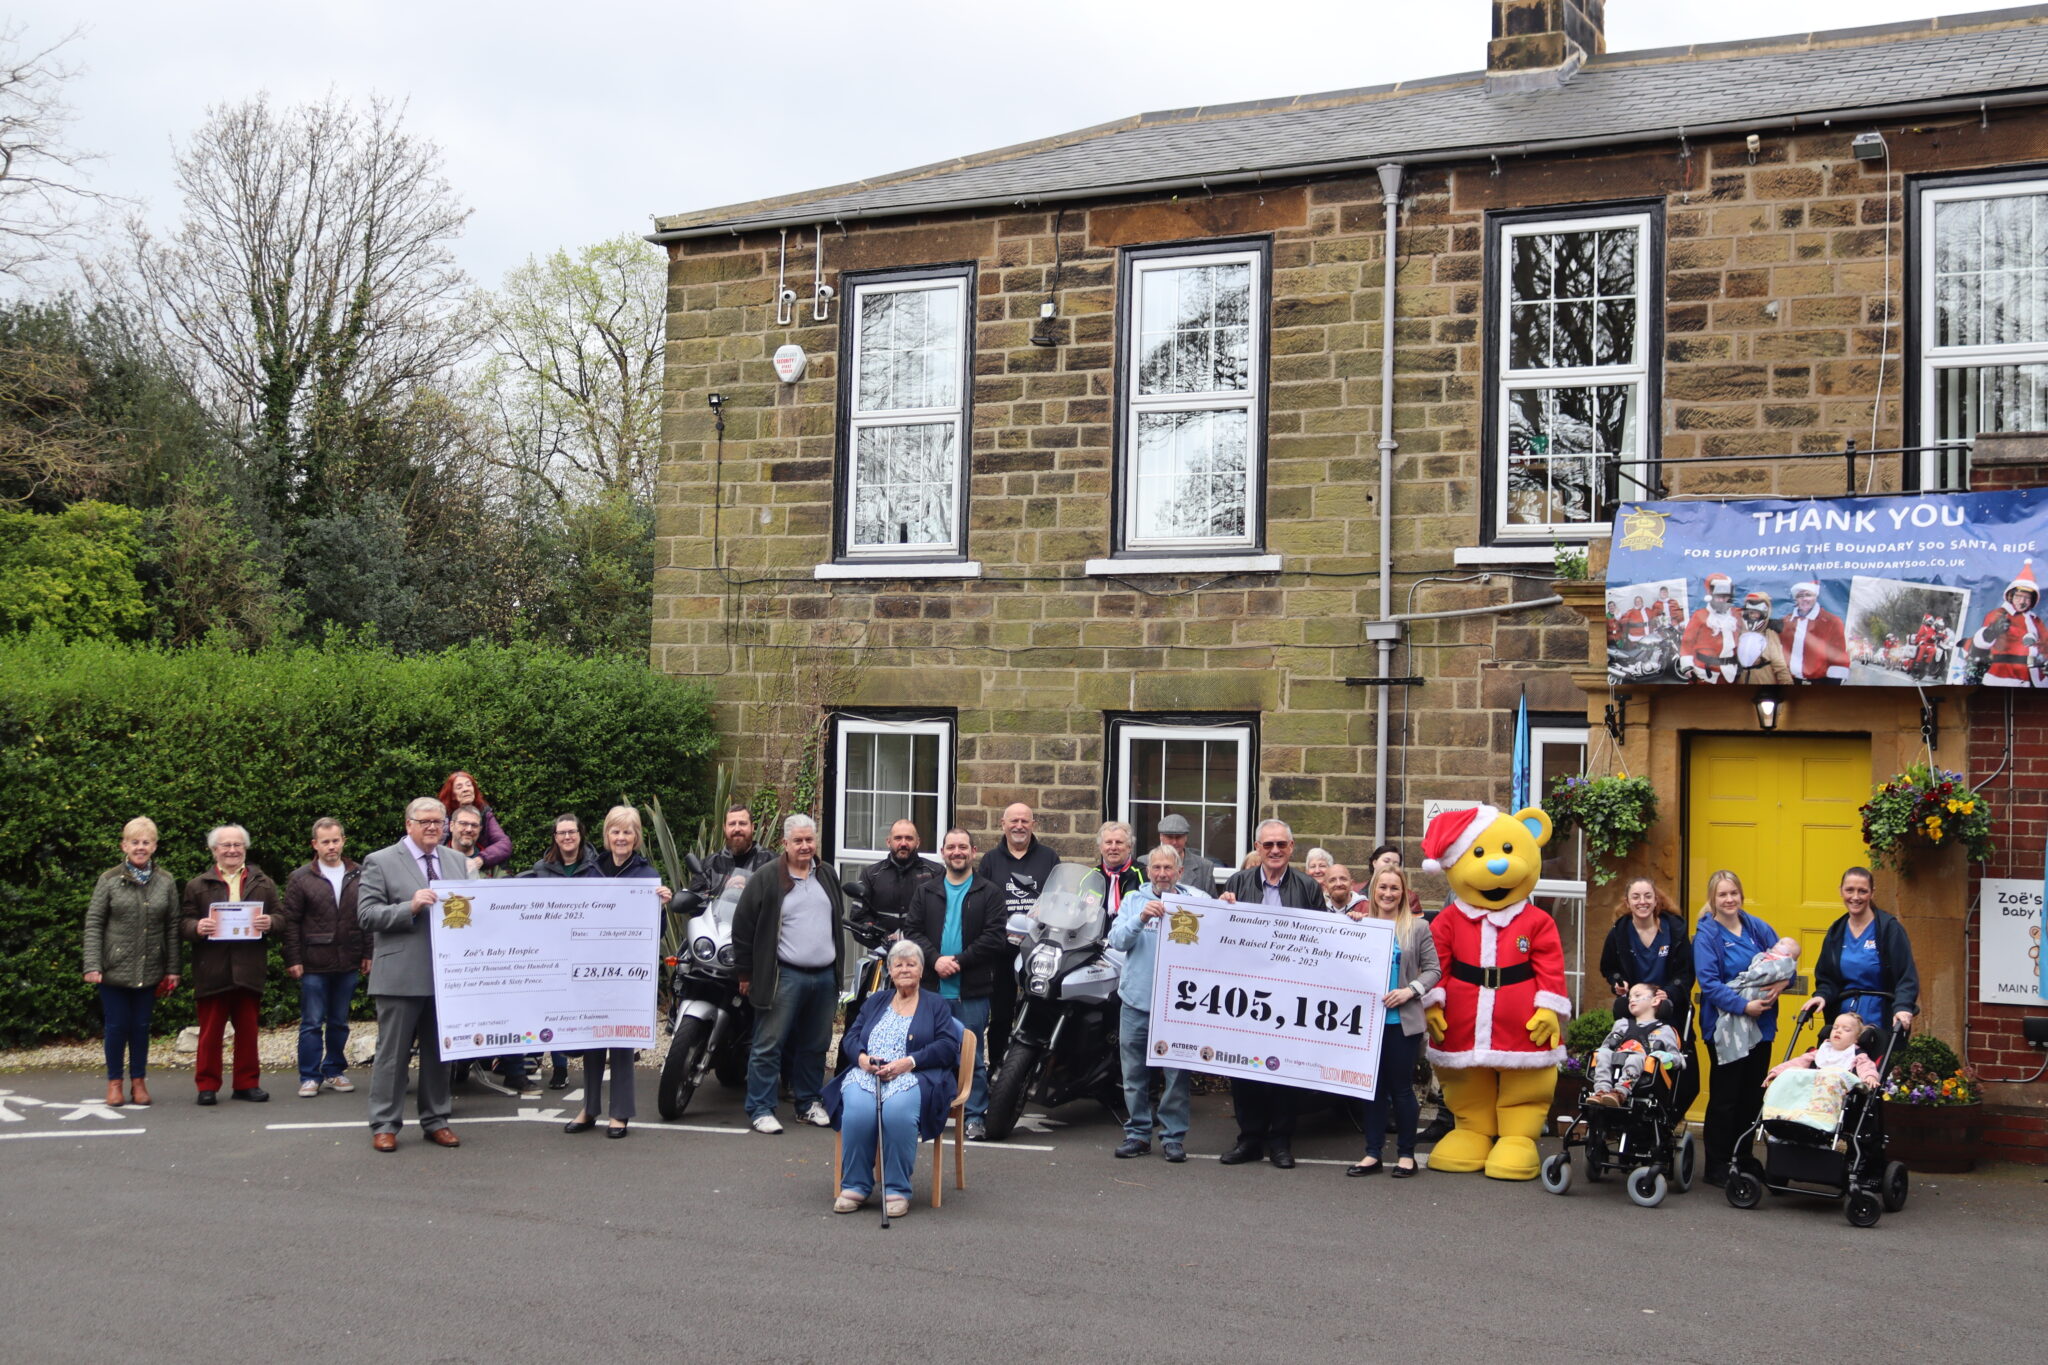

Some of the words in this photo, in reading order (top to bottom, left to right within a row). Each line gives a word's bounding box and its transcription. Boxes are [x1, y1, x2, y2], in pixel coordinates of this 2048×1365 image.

[1752, 508, 1877, 536] THANK
[1888, 503, 1965, 530] YOU
[1684, 548, 1710, 558] FOR
[1714, 544, 1801, 558] SUPPORTING
[1805, 542, 1831, 555] THE
[1835, 540, 1914, 553] BOUNDARY
[1918, 541, 1945, 551] 500
[1950, 539, 1997, 552] SANTA
[2002, 540, 2036, 553] RIDE
[1746, 558, 1966, 572] WWW.SANTARIDE.BOUNDARY500.CO.UK
[1998, 892, 2043, 905] Zoë's
[489, 902, 528, 911] Boundary
[546, 901, 589, 910] Motorcycle
[591, 901, 617, 910] Group
[2002, 907, 2035, 919] Baby
[519, 912, 542, 920] Santa
[544, 912, 563, 920] Ride
[1229, 914, 1272, 927] Boundary
[1273, 918, 1290, 928] 500
[1290, 920, 1338, 935] Motorcycle
[1339, 927, 1367, 940] Group
[1272, 930, 1297, 941] Santa
[486, 947, 506, 958] Baby
[508, 946, 540, 957] Hospice
[1219, 935, 1237, 945] Has
[1238, 937, 1268, 949] Raised
[1269, 941, 1286, 951] For
[1311, 947, 1333, 959] Baby
[1270, 953, 1291, 963] 2006
[1298, 956, 1319, 967] 2023
[573, 967, 581, 978] £
[628, 966, 649, 980] 60p
[1998, 983, 2028, 993] MAIN
[1174, 980, 1363, 1036] £405,184
[614, 1024, 651, 1039] MOTORCYCLES
[486, 1033, 520, 1045] Ripla
[1215, 1050, 1249, 1065] Ripla
